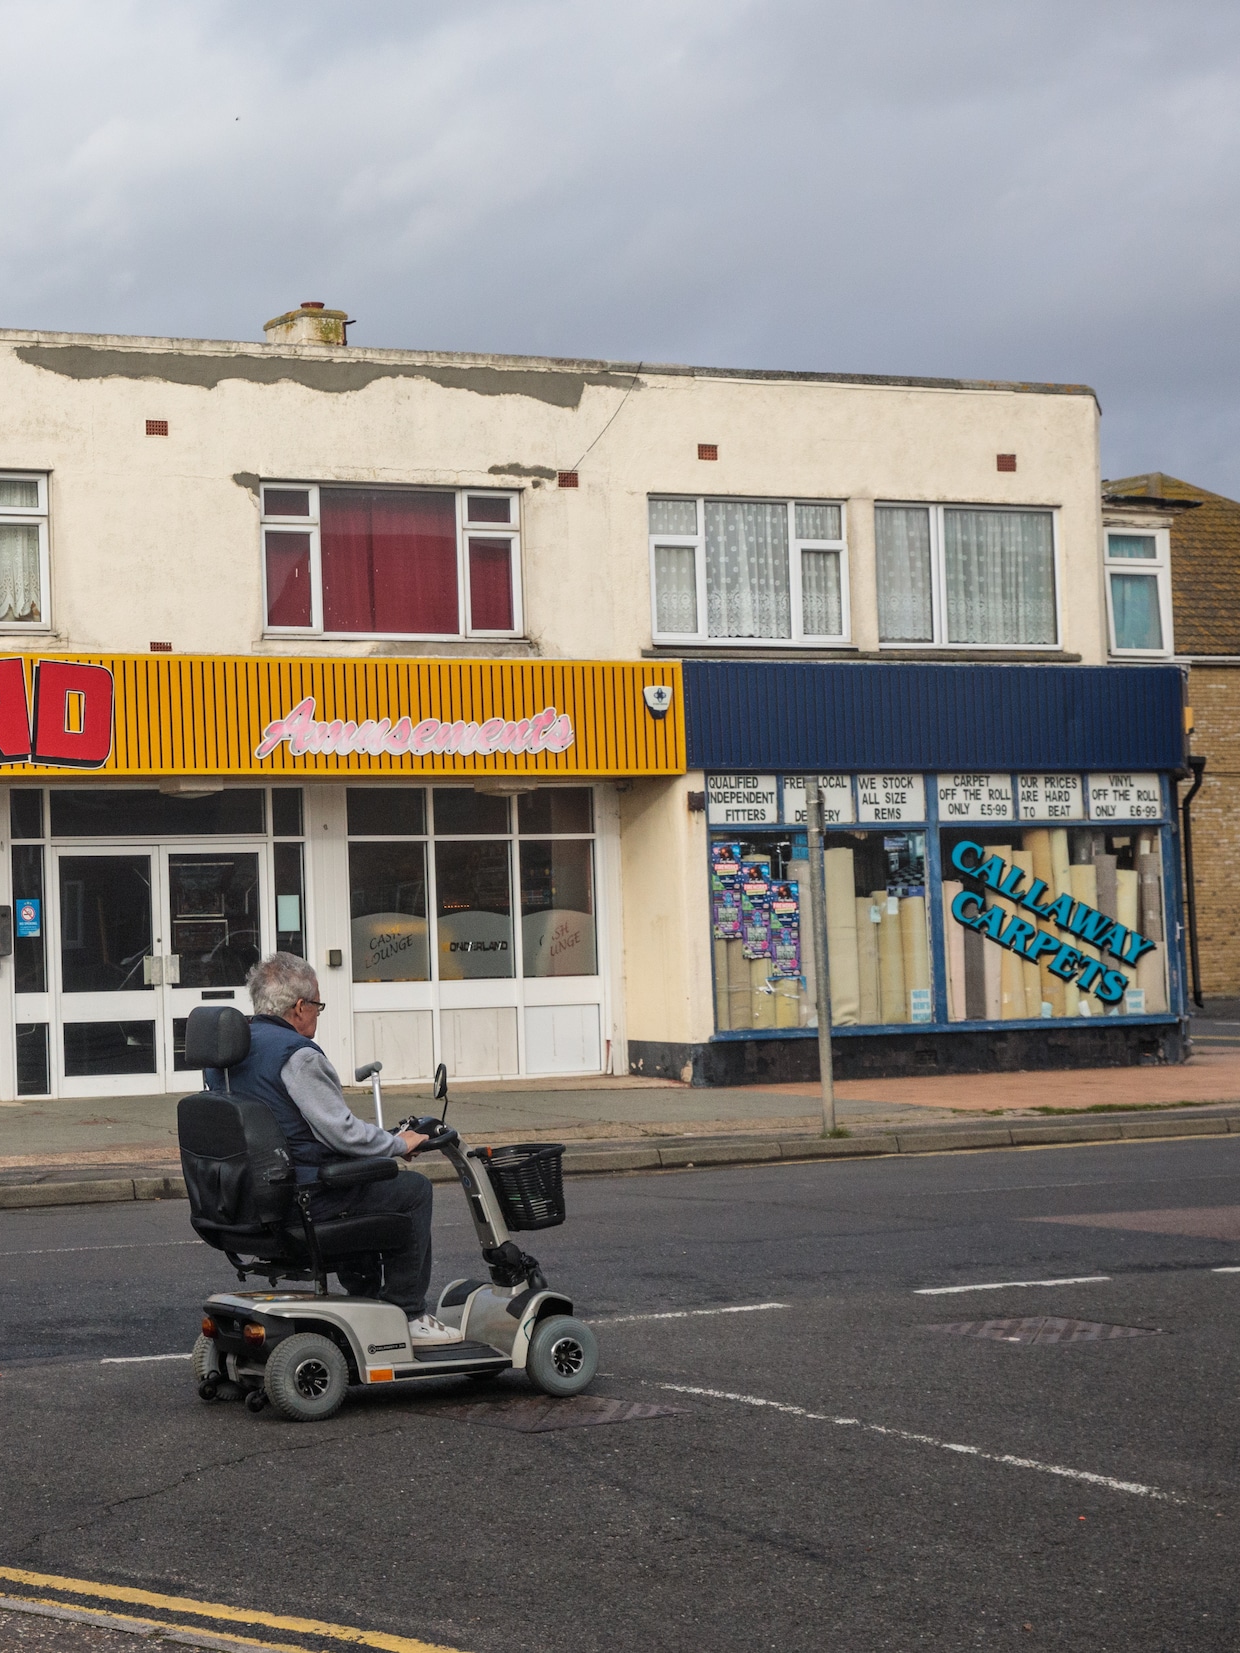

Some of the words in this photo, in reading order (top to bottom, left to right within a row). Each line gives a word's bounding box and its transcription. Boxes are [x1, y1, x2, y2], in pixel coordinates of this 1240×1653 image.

[255, 696, 575, 760] Amusements
[709, 776, 759, 789] QUALIFIED
[817, 776, 847, 788] LOCAL
[858, 777, 876, 790] WE
[882, 776, 914, 789] STOCK
[953, 775, 990, 787] CARPET
[1020, 776, 1039, 788] OUR
[1044, 776, 1078, 789] PRICES
[1108, 775, 1134, 787] VINYL
[708, 791, 775, 804] INDEPENDENT
[862, 792, 880, 805] ALL
[885, 792, 907, 805] SIZE
[939, 788, 957, 800] OFF
[963, 789, 982, 800] THE
[988, 788, 1011, 801] ROLL
[1020, 790, 1039, 802] ARE
[1045, 790, 1071, 802] HARD
[1091, 788, 1109, 801] OFF
[1112, 789, 1131, 802] THE
[1136, 790, 1159, 802] ROLL
[725, 809, 766, 822] FITTERS
[874, 808, 902, 820] REMS
[948, 803, 970, 815] ONLY
[1023, 806, 1036, 818] TO
[1048, 805, 1072, 817] BEAT
[1095, 805, 1117, 817] ONLY
[794, 810, 841, 822] DEERY
[951, 840, 1158, 969] CALLAWAY
[441, 940, 508, 953] ONDERLAND
[951, 890, 1130, 1006] CARPETS
